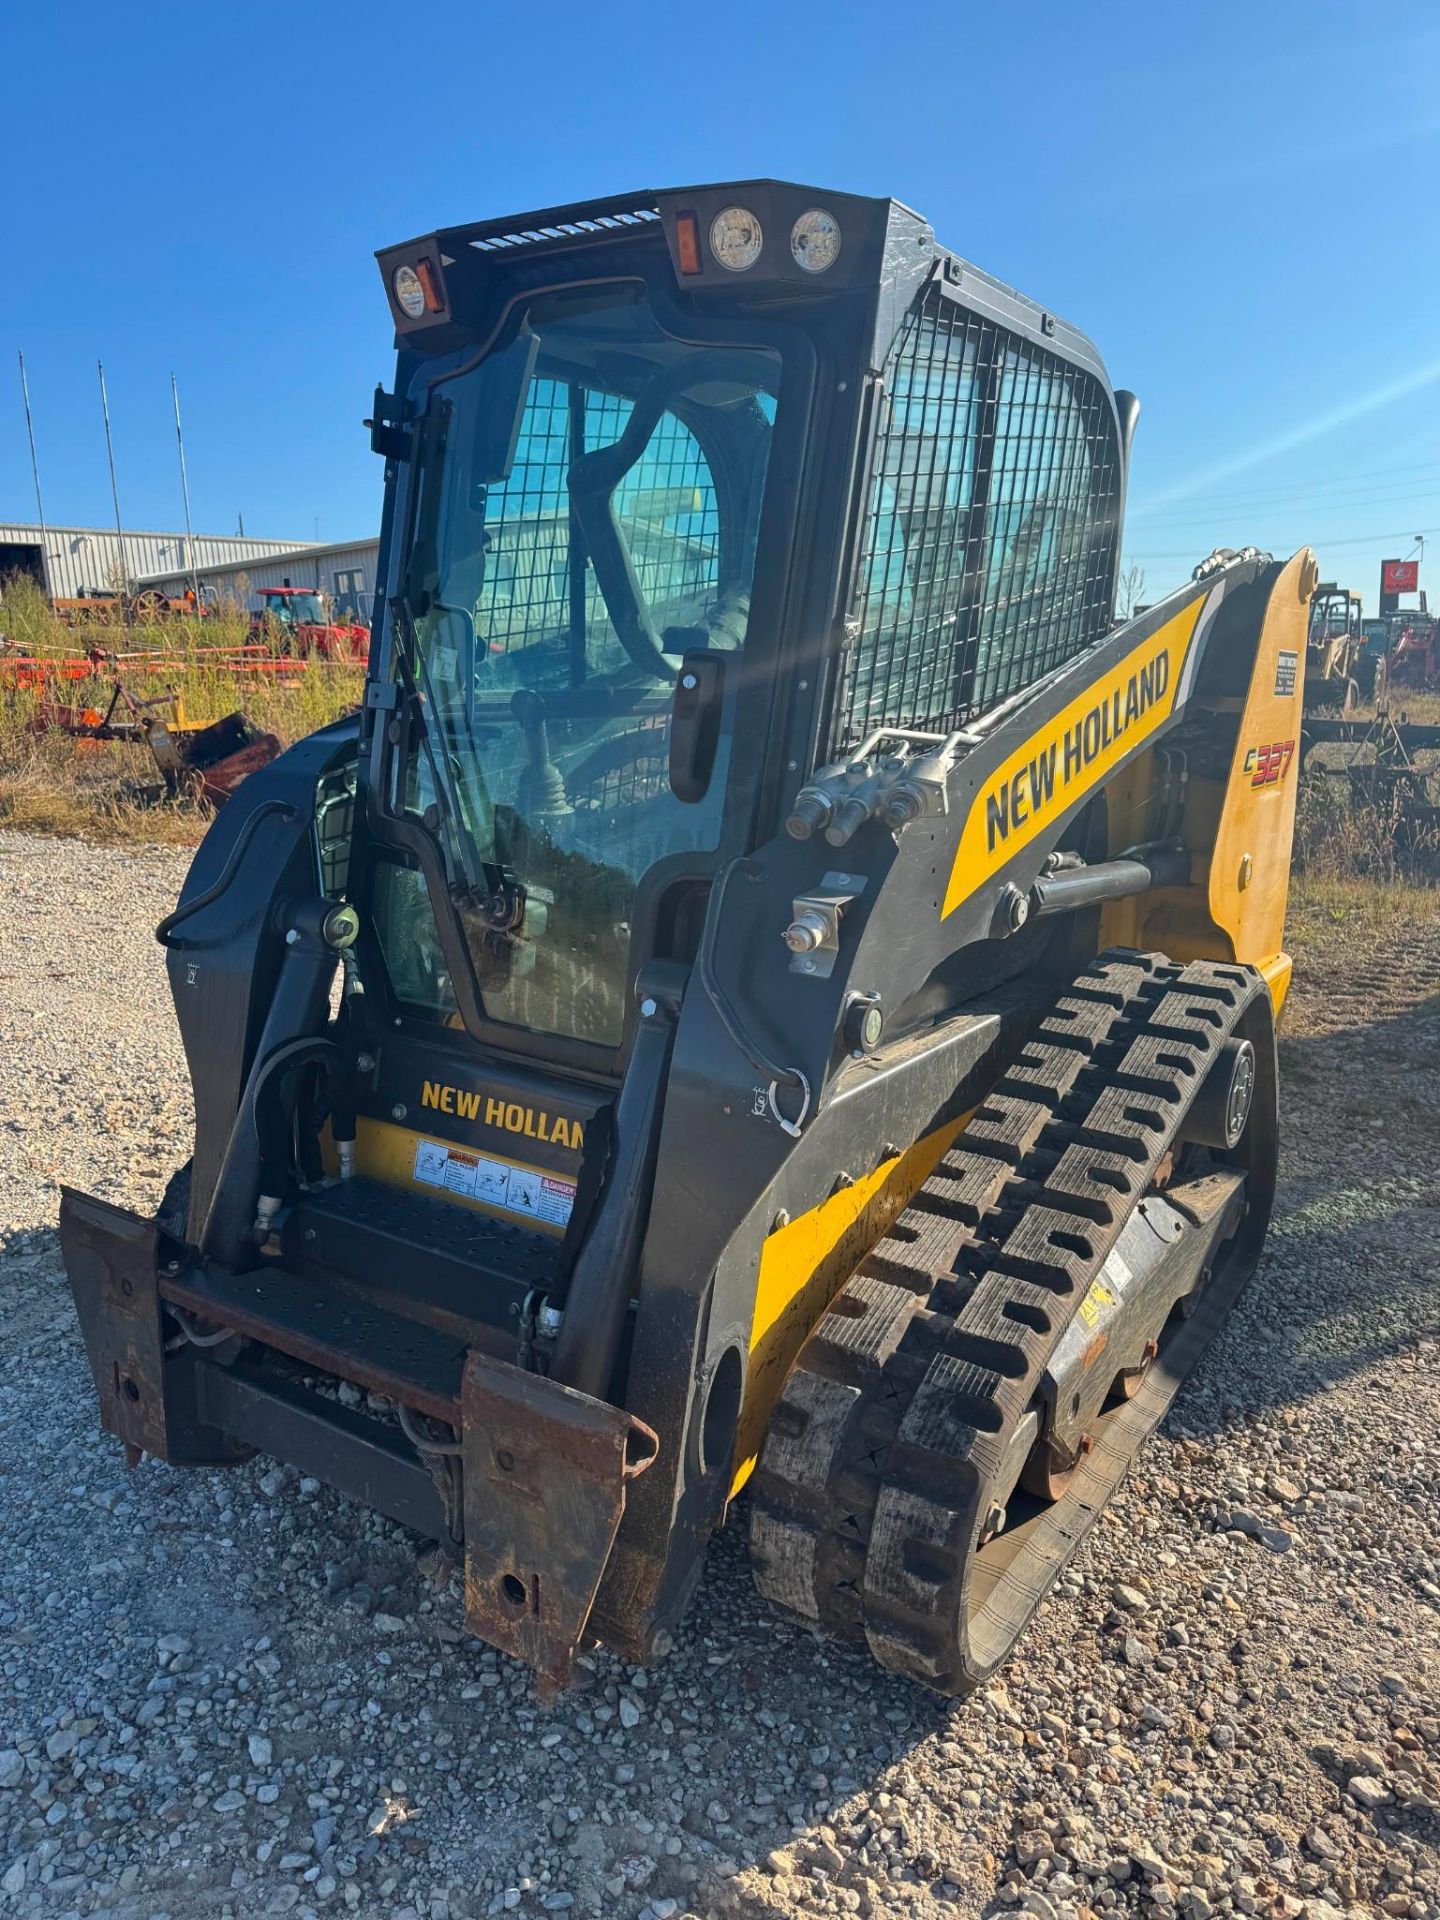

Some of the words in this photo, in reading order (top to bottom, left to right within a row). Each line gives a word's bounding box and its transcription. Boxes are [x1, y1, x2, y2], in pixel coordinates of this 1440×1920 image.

[986, 739, 1057, 854] NEW
[1063, 648, 1169, 786] HOLLAND
[421, 1080, 481, 1120] NEW
[485, 1097, 584, 1150] HOLLAN
[549, 1180, 576, 1195] DANGER
